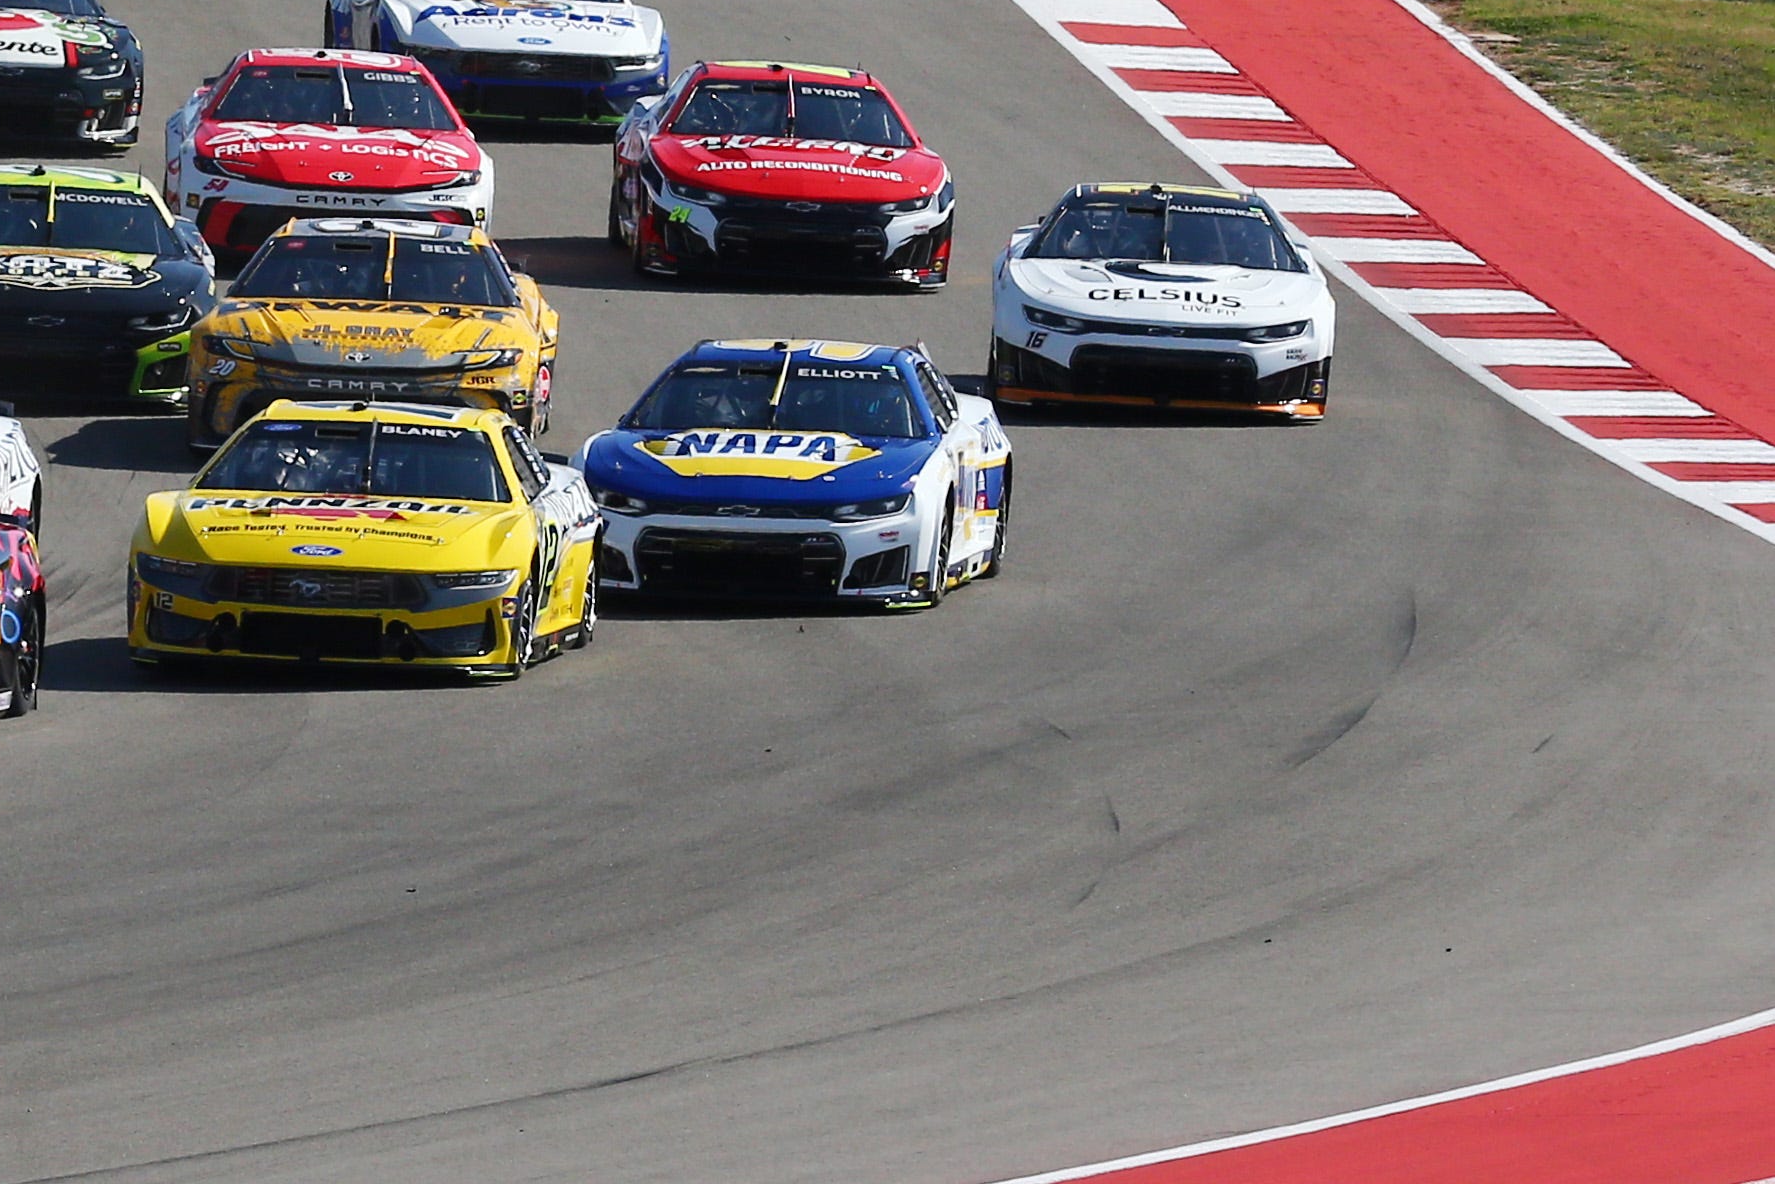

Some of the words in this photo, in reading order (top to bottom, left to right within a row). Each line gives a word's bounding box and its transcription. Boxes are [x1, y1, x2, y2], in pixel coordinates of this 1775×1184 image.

[453, 16, 513, 27] Rent
[525, 16, 545, 27] to
[551, 19, 612, 34] Own
[363, 71, 418, 85] GIBBS
[800, 86, 861, 100] BYRON
[214, 141, 311, 159] FREIGHT
[697, 160, 749, 172] AUTO
[750, 160, 903, 182] RECONDITIONING
[54, 191, 149, 207] MCDOWELL
[296, 195, 388, 207] CAMRY
[670, 206, 692, 224] 24
[420, 243, 470, 256] BELL
[1087, 287, 1243, 309] CELSIUS
[1181, 304, 1213, 315] LIVE
[1216, 307, 1238, 317] FIT
[1025, 331, 1049, 349] 16
[209, 359, 236, 376] 20
[797, 367, 882, 381] ELLIOTT
[307, 379, 409, 392] CAMRY
[466, 376, 496, 385] JGR
[381, 425, 463, 440] BLANEY
[674, 432, 837, 462] NAPA
[208, 524, 241, 533] Race
[295, 523, 342, 533] Trusted
[344, 525, 361, 535] by
[154, 591, 173, 611] 12
